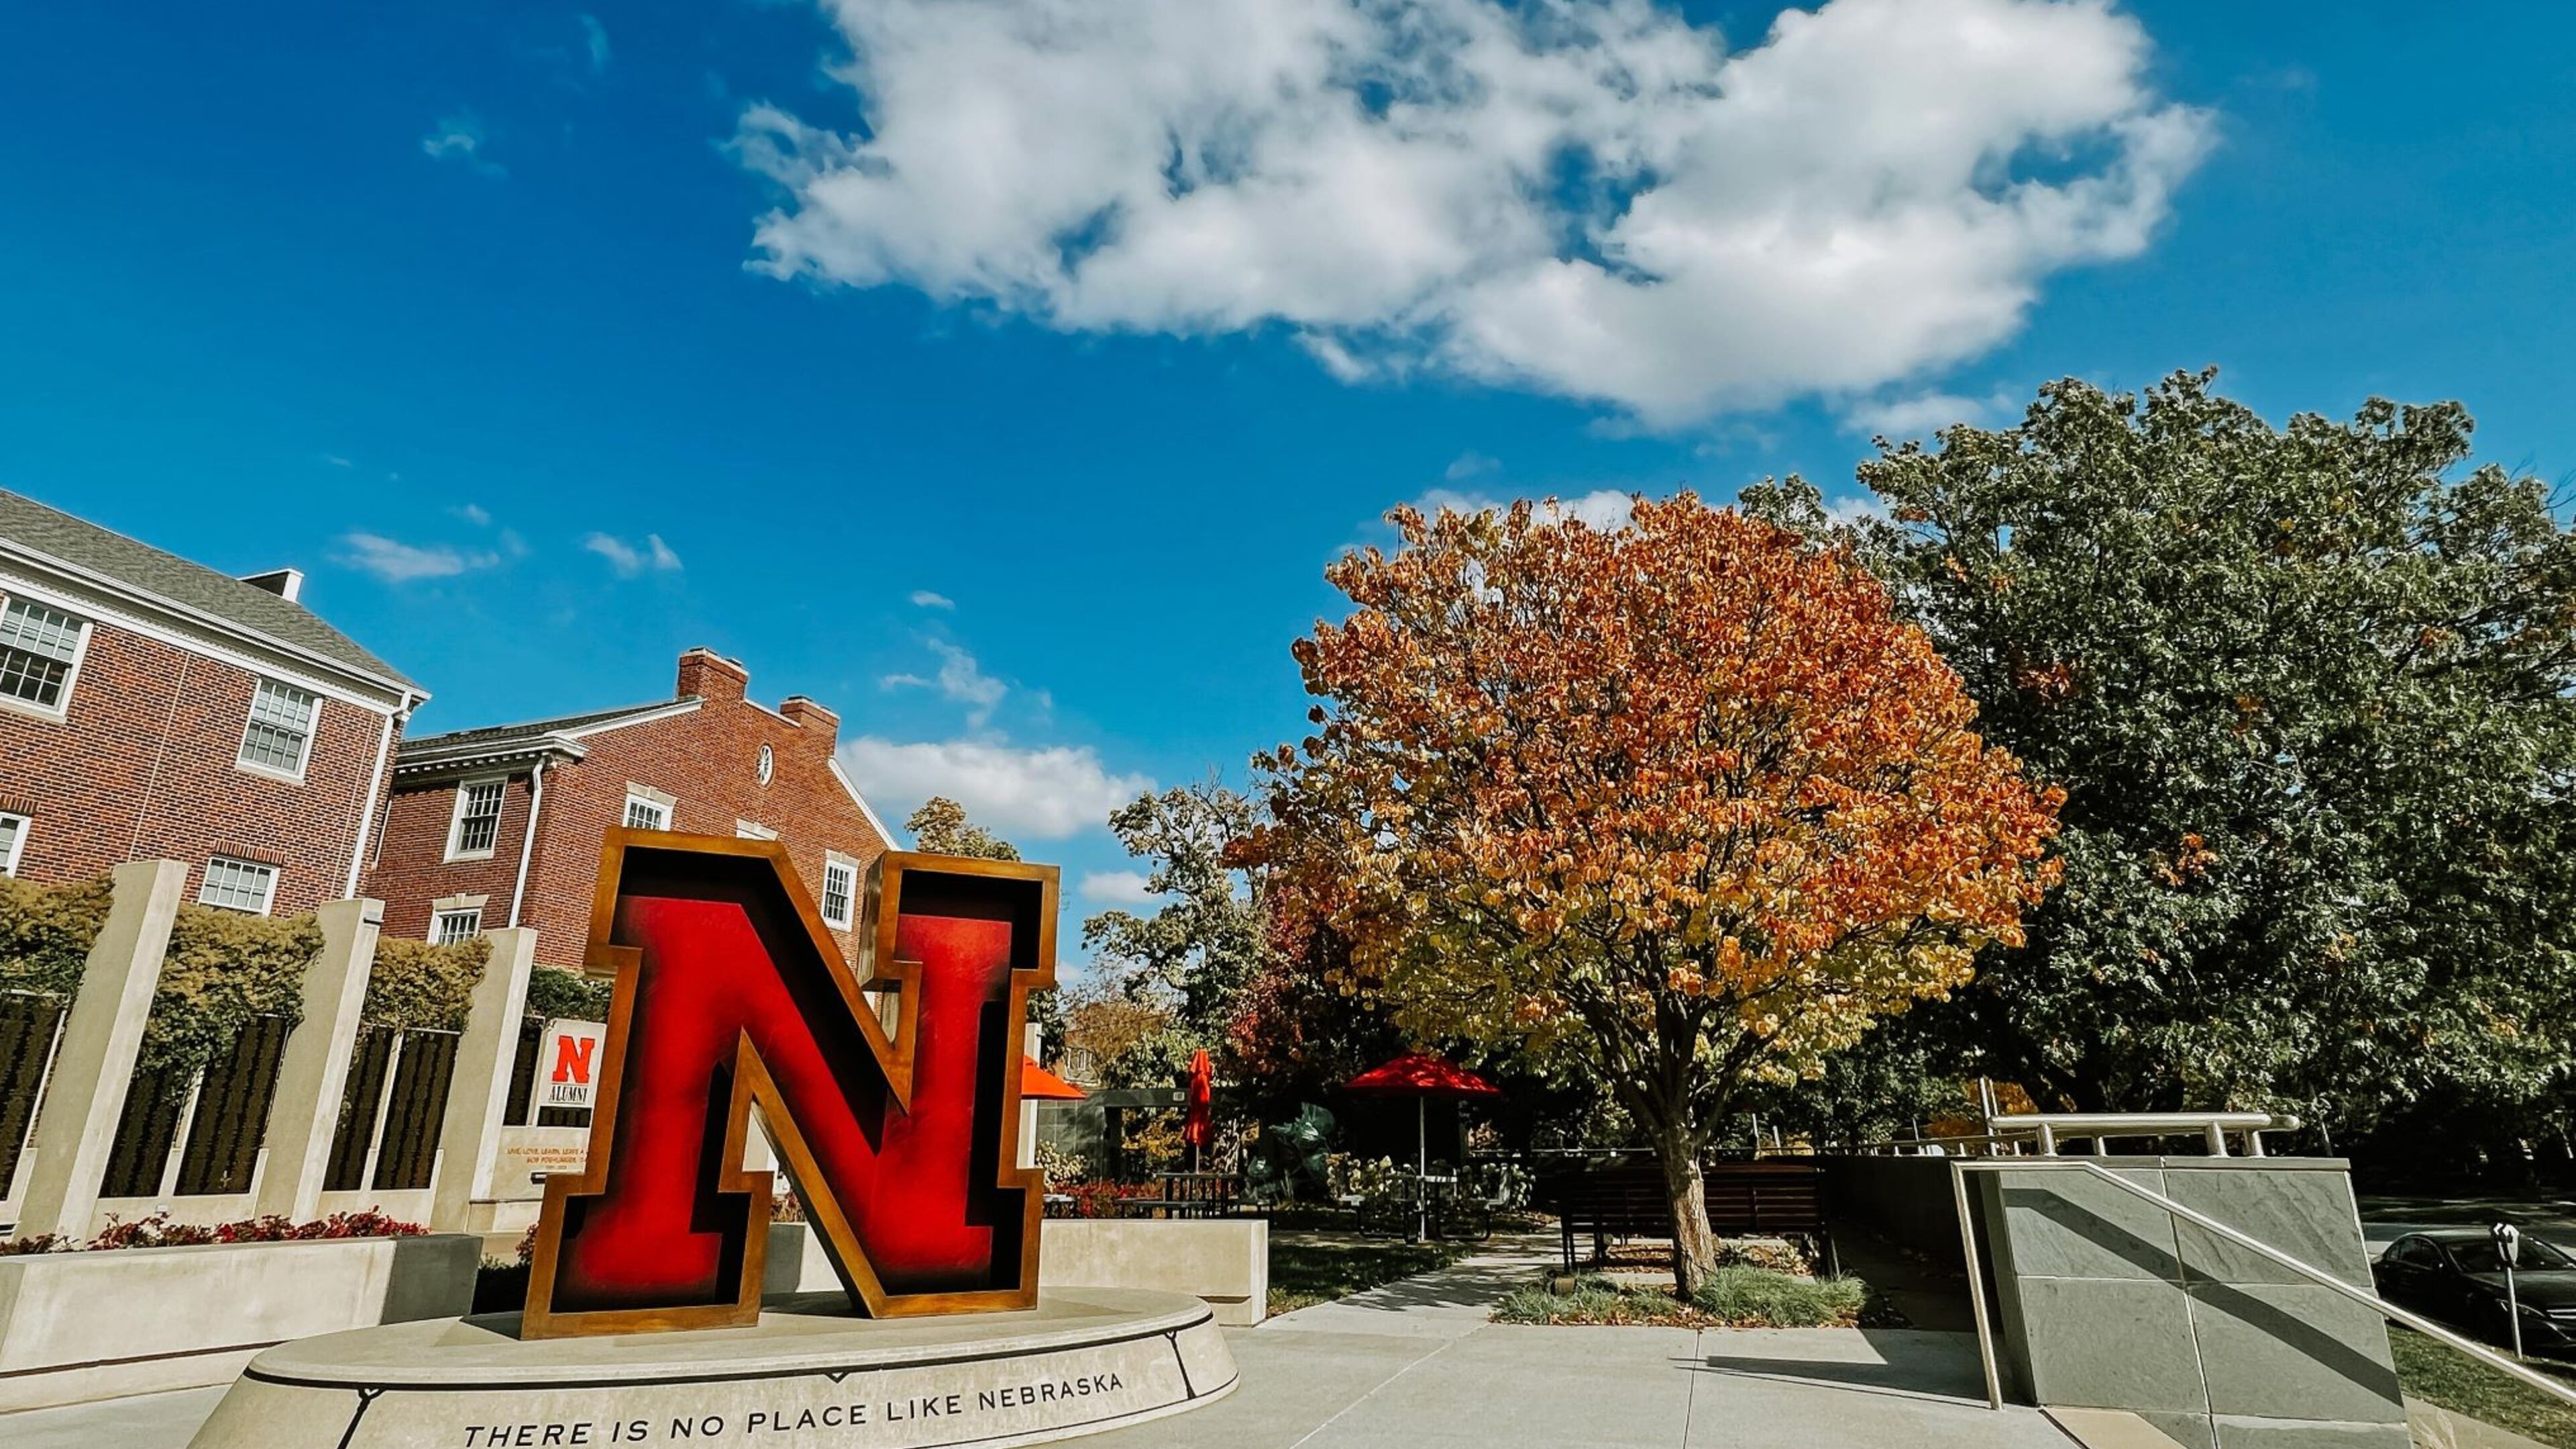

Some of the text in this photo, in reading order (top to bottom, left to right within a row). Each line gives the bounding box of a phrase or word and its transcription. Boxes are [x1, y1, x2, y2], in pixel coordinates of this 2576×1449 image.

[521, 825, 1060, 1340] N
[551, 1035, 595, 1083] N
[548, 1085, 588, 1102] ALUMNI
[465, 1373, 1122, 1448] THERE IS NO PLACE LIKE NEBRASKA
